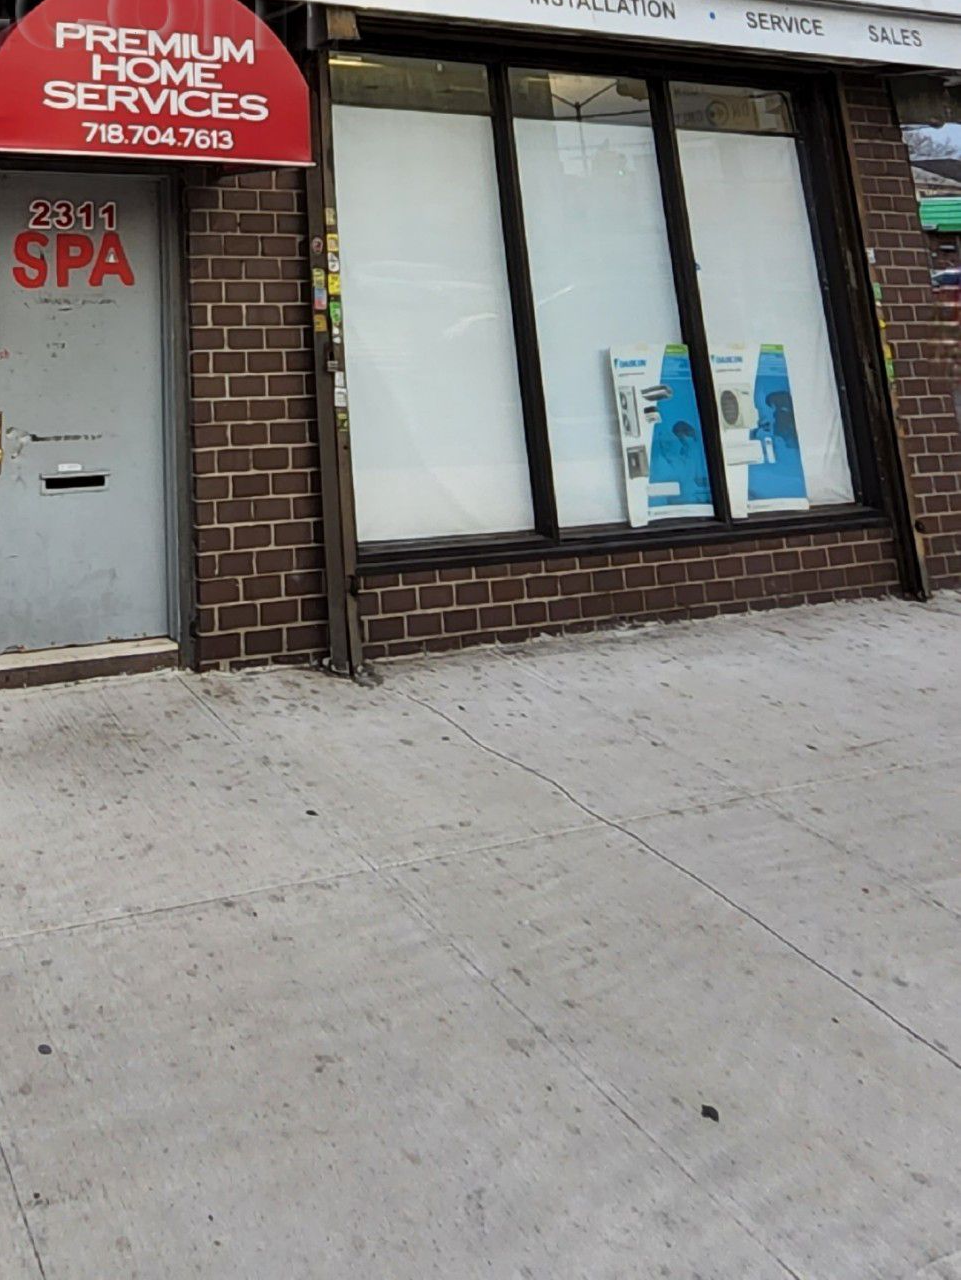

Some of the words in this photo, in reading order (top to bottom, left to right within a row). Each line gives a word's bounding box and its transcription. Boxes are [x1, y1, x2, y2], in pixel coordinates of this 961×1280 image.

[55, 21, 255, 65] PREMIUM
[745, 11, 825, 37] SERVICE
[868, 25, 923, 48] SALES
[91, 54, 223, 90] HOME
[42, 81, 269, 122] SERVICES
[81, 122, 234, 150] 718.704.7613
[29, 200, 117, 230] 2311
[12, 231, 135, 289] SPA
